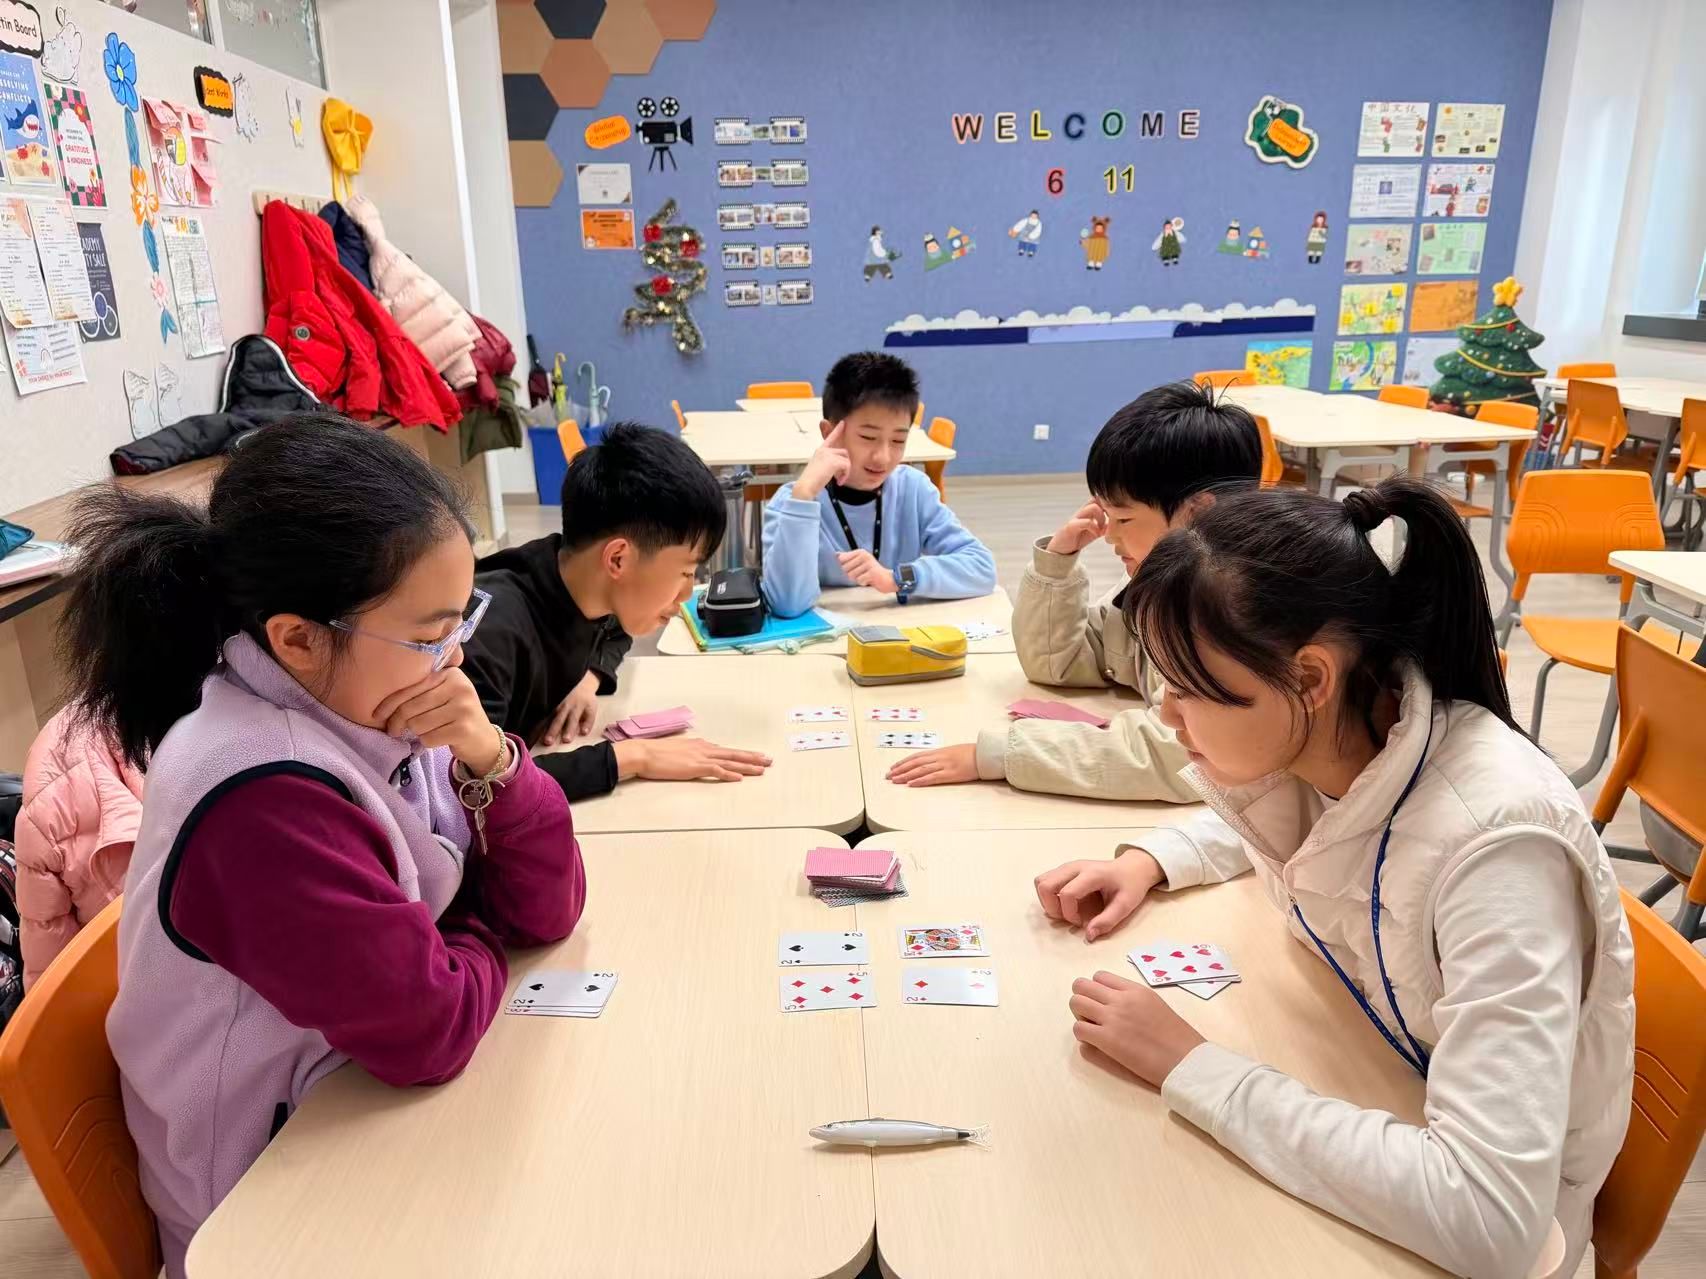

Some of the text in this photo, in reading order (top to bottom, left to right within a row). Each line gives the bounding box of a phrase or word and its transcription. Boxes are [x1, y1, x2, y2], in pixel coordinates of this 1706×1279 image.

[14, 19, 37, 38] Board
[953, 110, 1200, 144] WELCOME
[65, 144, 90, 154] GRATITUDE
[1047, 163, 1134, 197] 6 11
[94, 252, 107, 267] SALE
